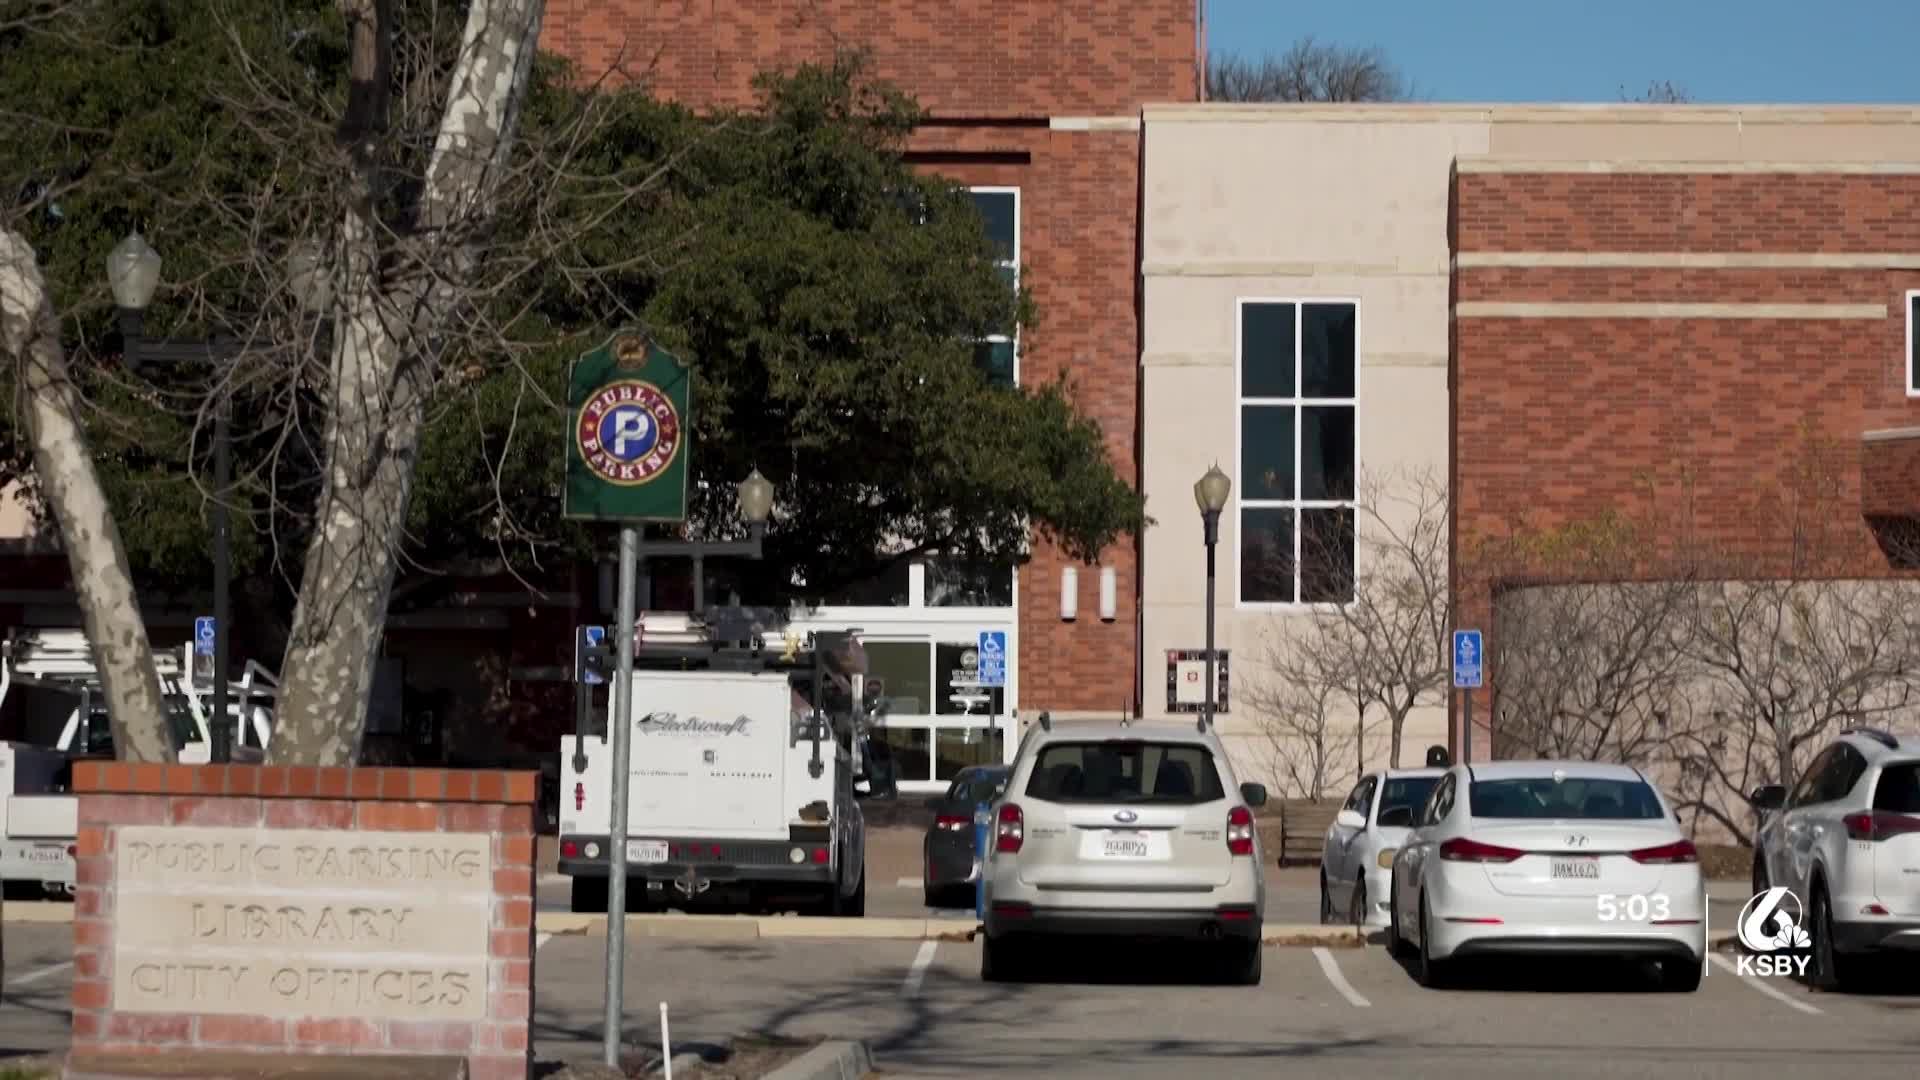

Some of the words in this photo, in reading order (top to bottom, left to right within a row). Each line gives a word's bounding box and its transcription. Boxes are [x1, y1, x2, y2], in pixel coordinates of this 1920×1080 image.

[591, 387, 670, 419] PUBLIC
[614, 411, 649, 455] P
[584, 437, 672, 480] PARKING
[127, 841, 281, 873] PUBLIC
[294, 844, 482, 880] PARKING
[191, 903, 413, 943] LIBRARY
[130, 963, 250, 997] CITY
[269, 966, 471, 1006] OFFICES
